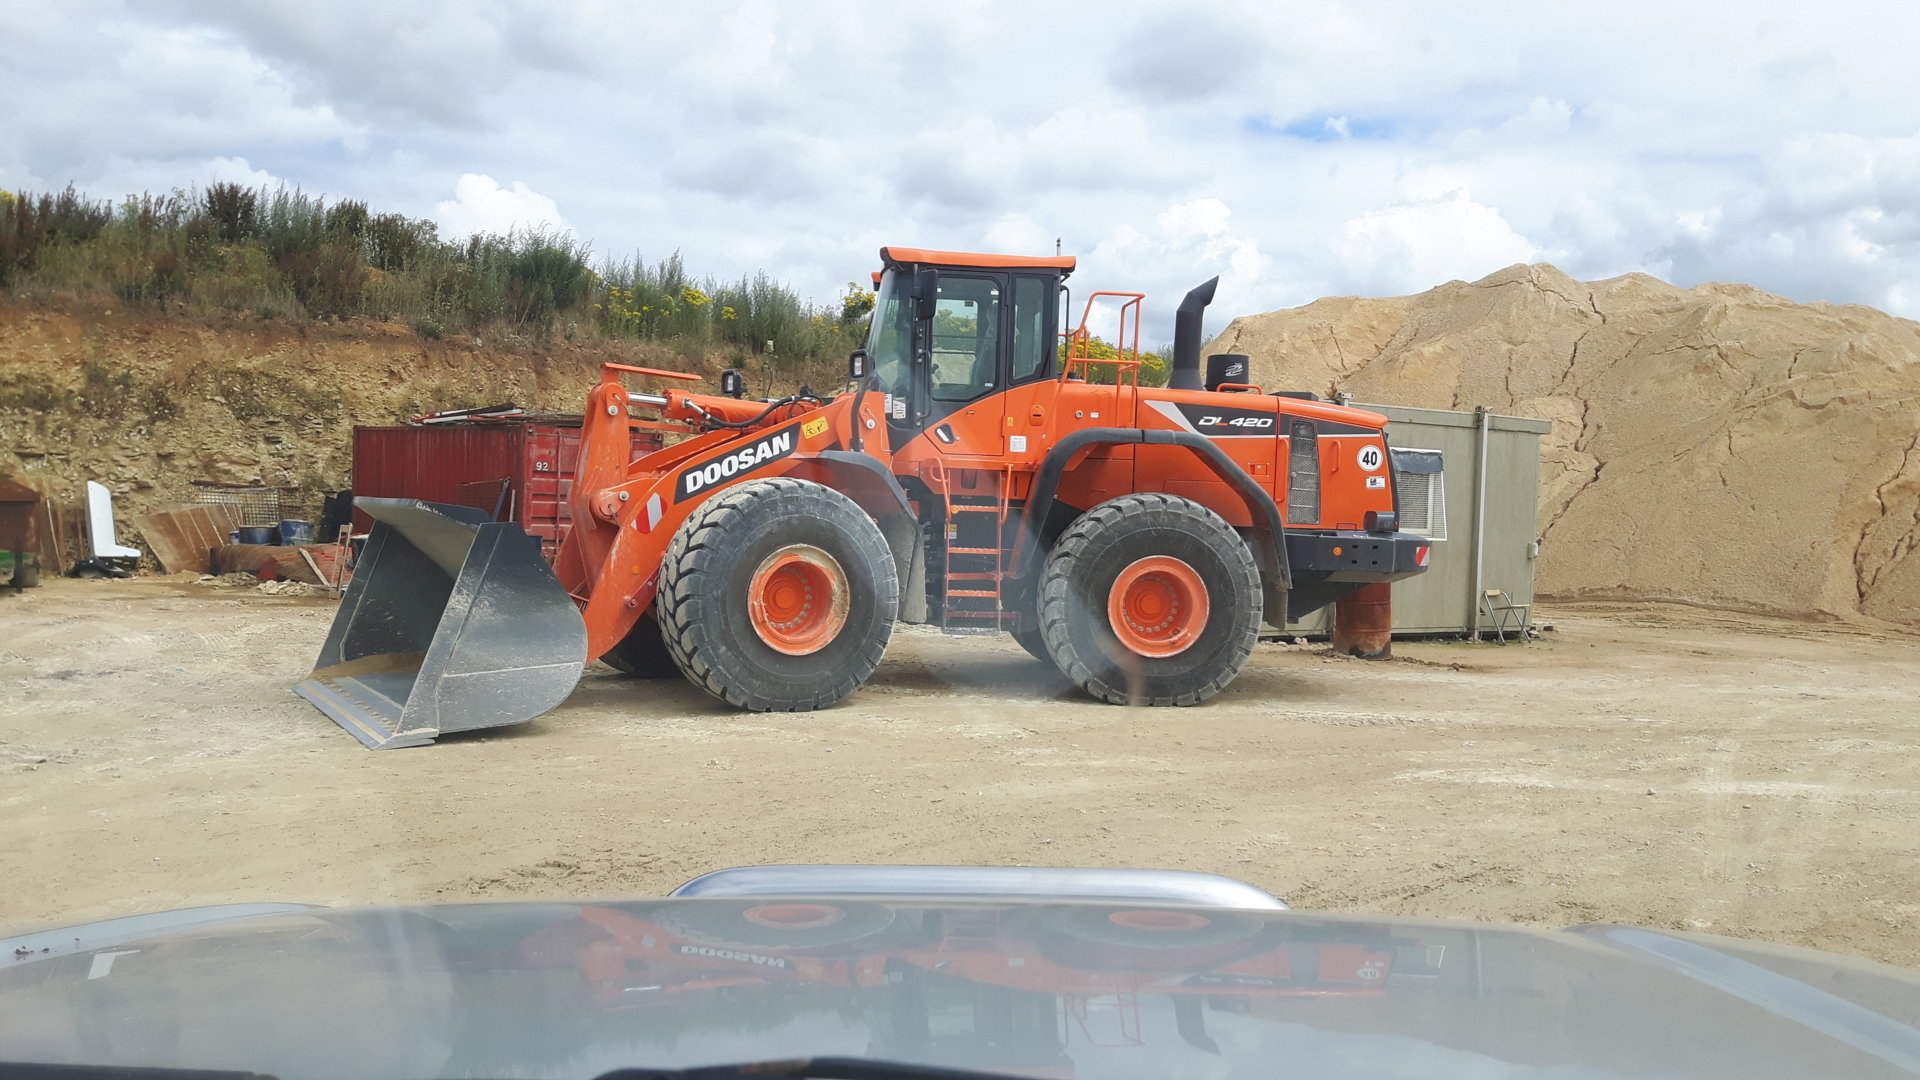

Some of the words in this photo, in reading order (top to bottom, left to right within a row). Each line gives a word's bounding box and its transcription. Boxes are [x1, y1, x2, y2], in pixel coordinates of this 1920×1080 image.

[685, 431, 791, 494] DOOSAN
[1362, 450, 1378, 466] 40
[536, 461, 549, 472] 92
